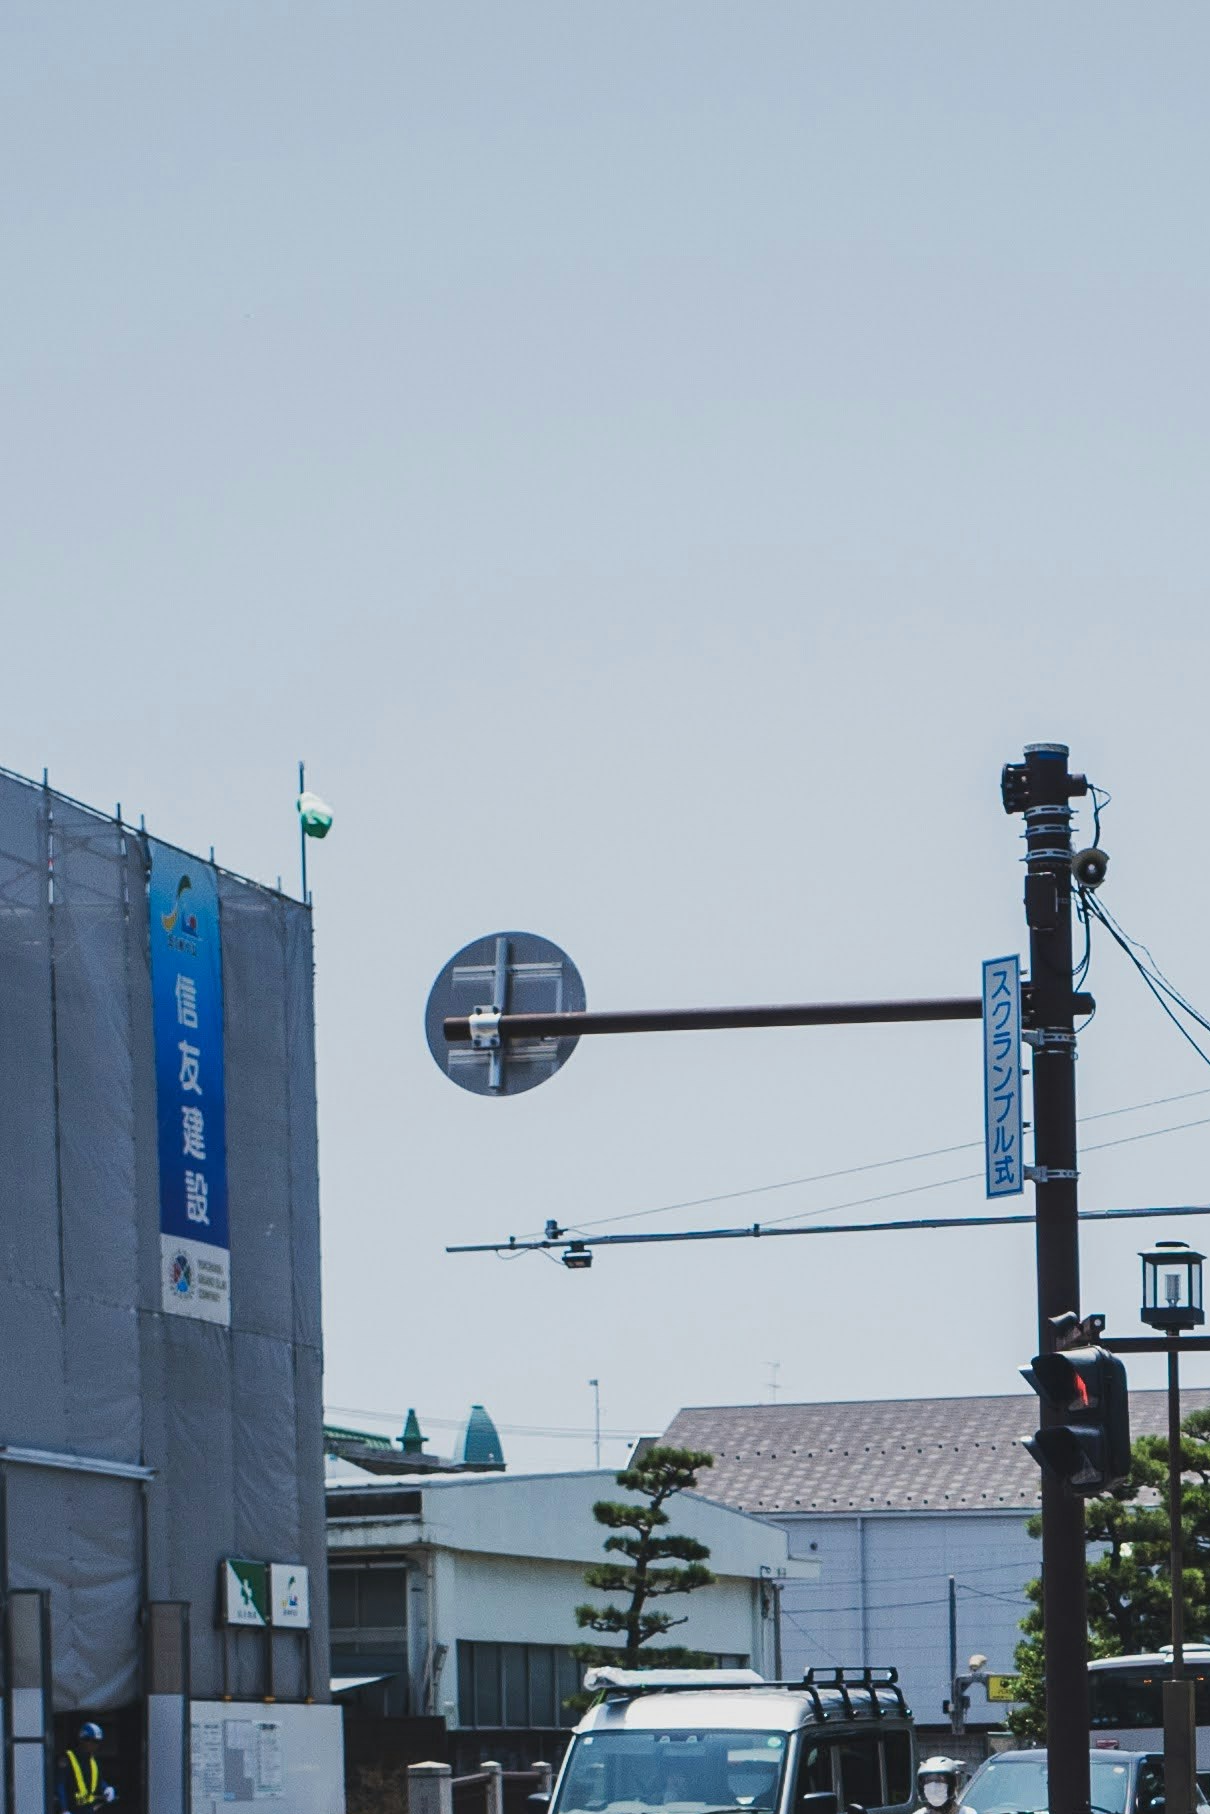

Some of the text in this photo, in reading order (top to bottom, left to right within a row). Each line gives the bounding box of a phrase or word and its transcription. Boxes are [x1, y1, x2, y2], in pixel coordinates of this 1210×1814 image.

[175, 972, 210, 1226] 信友建設
[992, 970, 1015, 1185] スクランブル式
